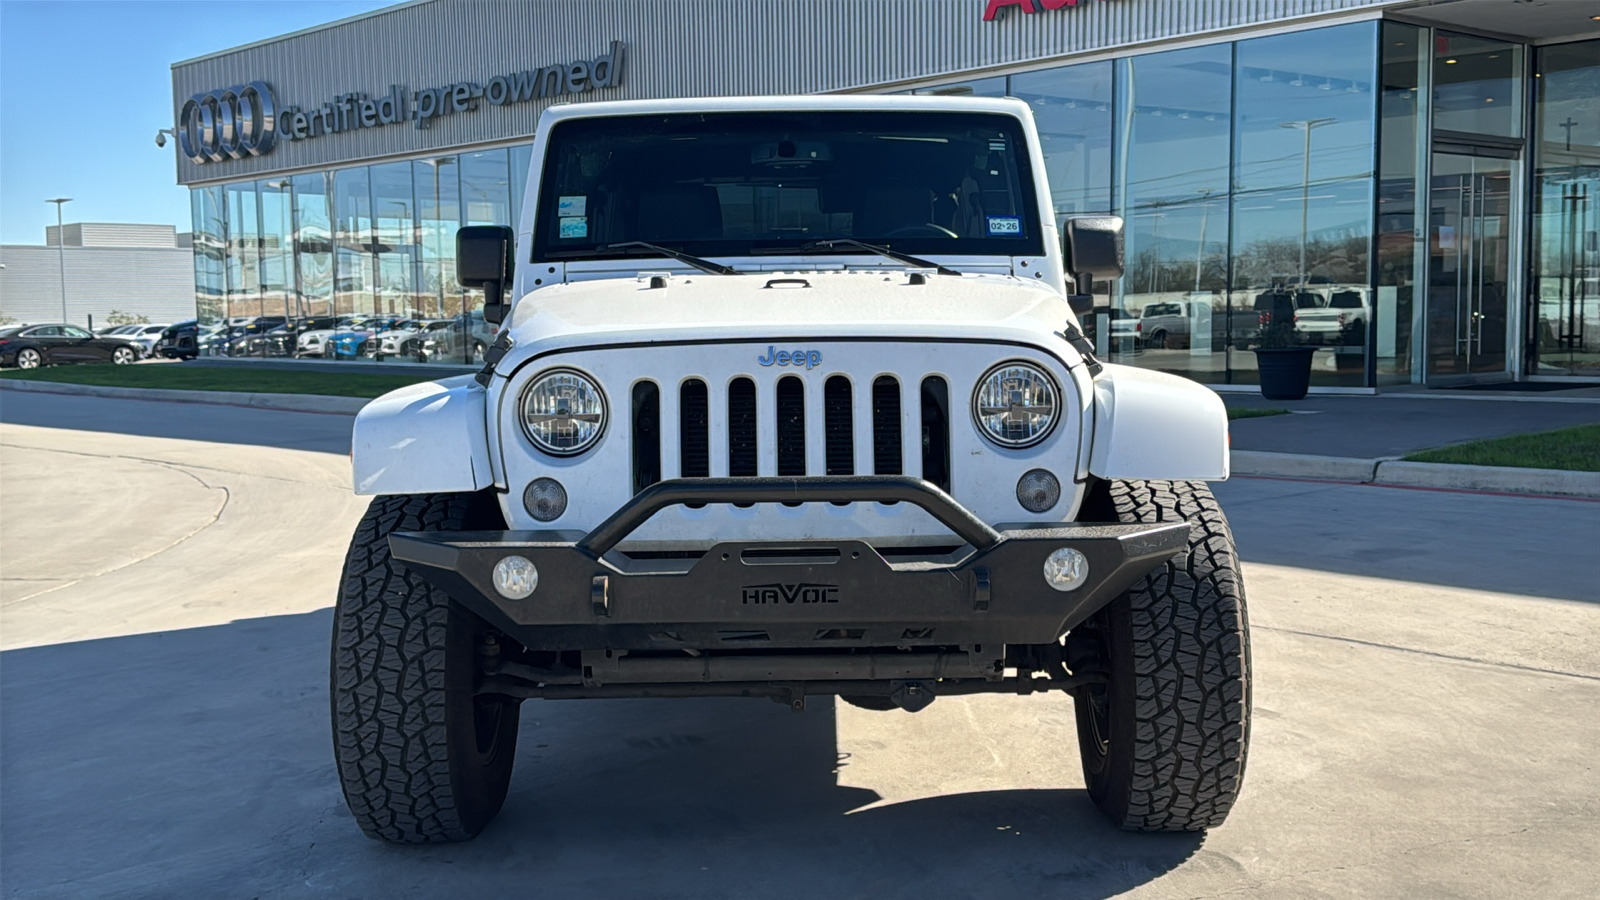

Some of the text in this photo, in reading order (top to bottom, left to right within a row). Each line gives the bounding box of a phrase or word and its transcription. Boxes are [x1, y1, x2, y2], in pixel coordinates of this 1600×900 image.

[276, 84, 404, 141] Certified
[758, 345, 823, 370] Jeep
[742, 583, 839, 604] HAVOC
